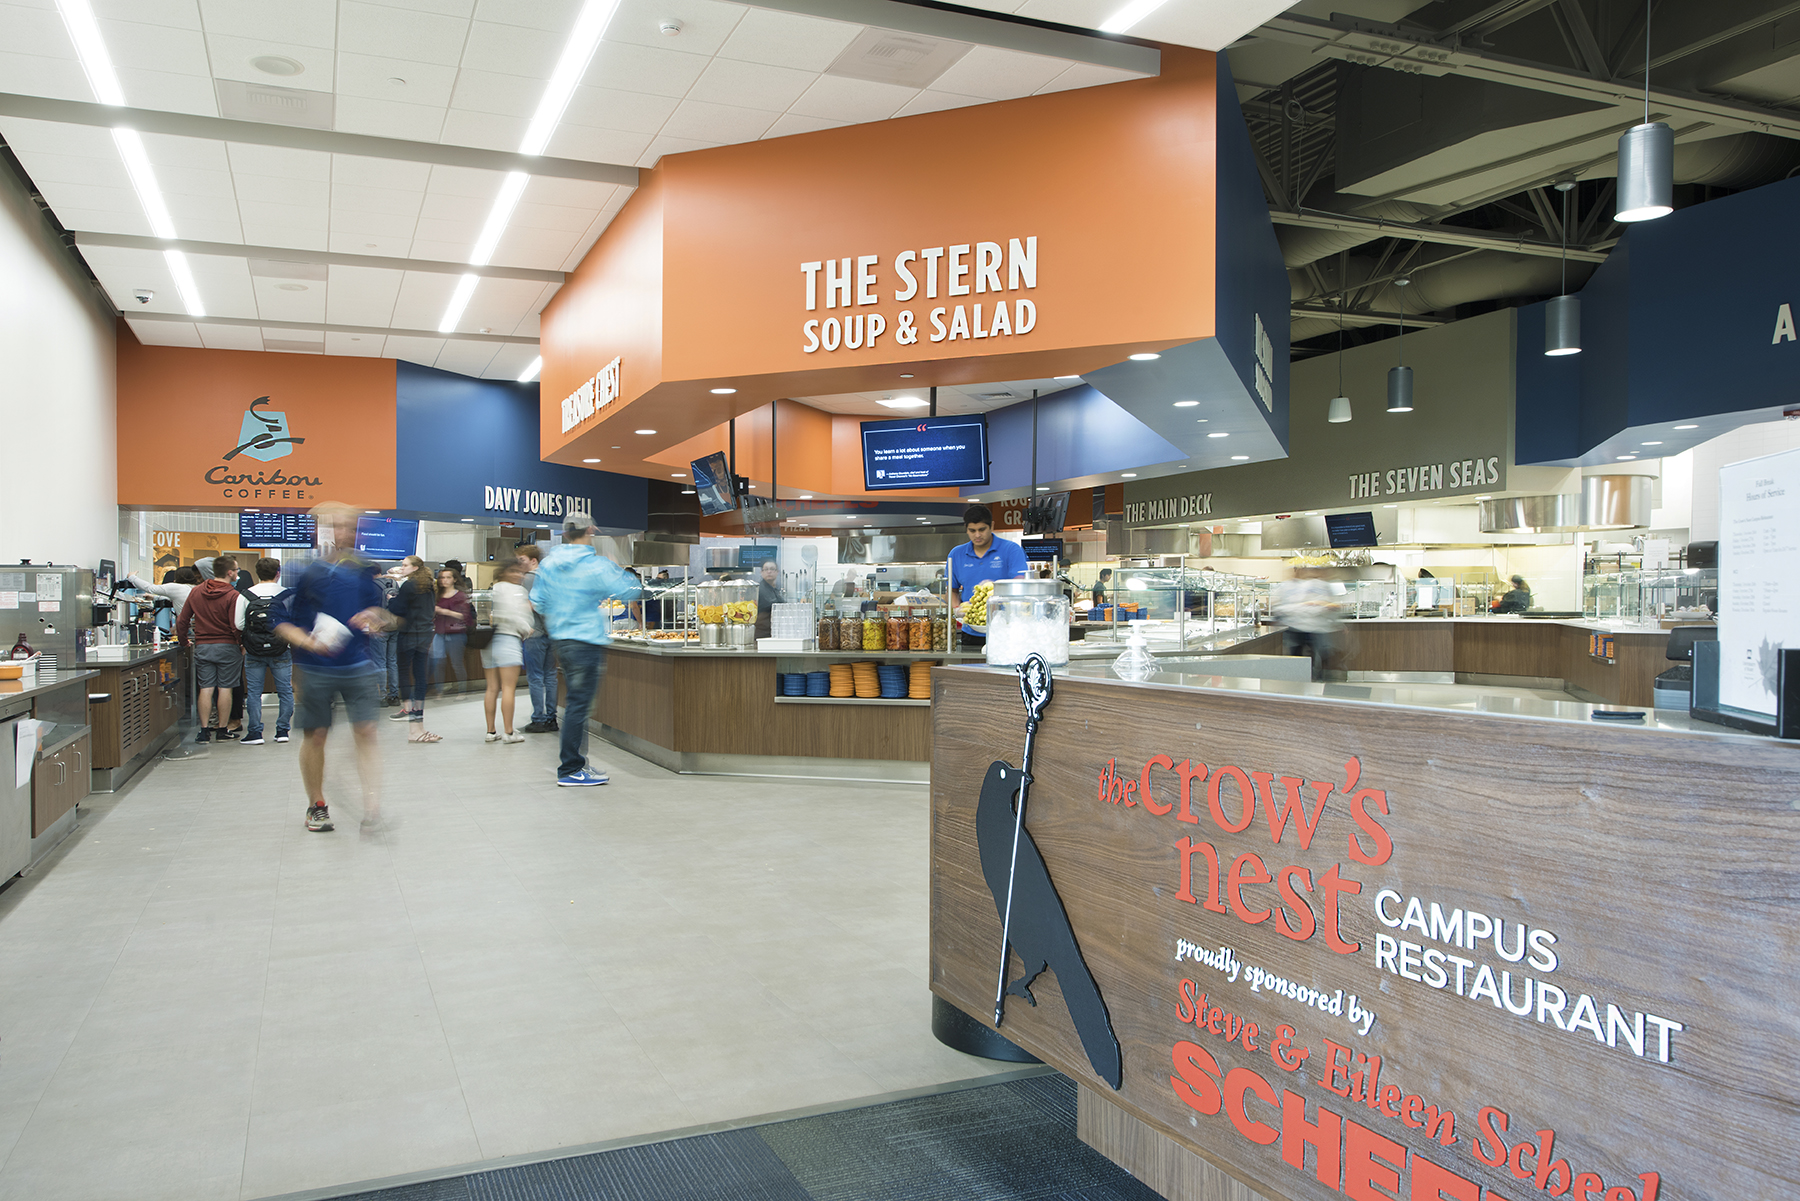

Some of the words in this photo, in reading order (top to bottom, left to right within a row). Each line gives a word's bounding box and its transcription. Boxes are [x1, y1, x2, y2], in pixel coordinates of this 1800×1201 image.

[801, 254, 878, 310] THE
[894, 236, 1038, 301] STERN
[803, 313, 886, 353] SOUP
[895, 310, 918, 345] &
[929, 299, 1037, 342] SALAD
[1771, 303, 1797, 345] A
[595, 355, 621, 411] CHEST
[204, 465, 323, 486] Caribou
[223, 488, 305, 499] COFFEE
[484, 485, 521, 512] DAVY
[523, 490, 563, 517] JONES
[1349, 471, 1380, 499] THE
[1385, 464, 1443, 495] SEVEN
[1449, 456, 1499, 489] SEAS
[1746, 492, 1760, 502] Hours
[1768, 488, 1786, 498] Service
[775, 499, 879, 512] CHEELS
[1125, 502, 1146, 523] THE
[1148, 498, 1178, 520] MAIN
[1180, 493, 1212, 517] DECK
[1097, 757, 1138, 808] the
[1140, 753, 1394, 867] crow's
[1174, 836, 1362, 955] nest
[1374, 889, 1559, 973] CAMPUS
[1174, 938, 1242, 983] proudly
[1244, 965, 1344, 1017] sponsored
[1348, 995, 1376, 1036] by
[1375, 933, 1683, 1063] RESTAURANT
[1175, 978, 1260, 1052] Steve
[1270, 1024, 1310, 1072] &
[1317, 1038, 1457, 1147] Eileen
[1170, 1040, 1508, 1201] SCHE
